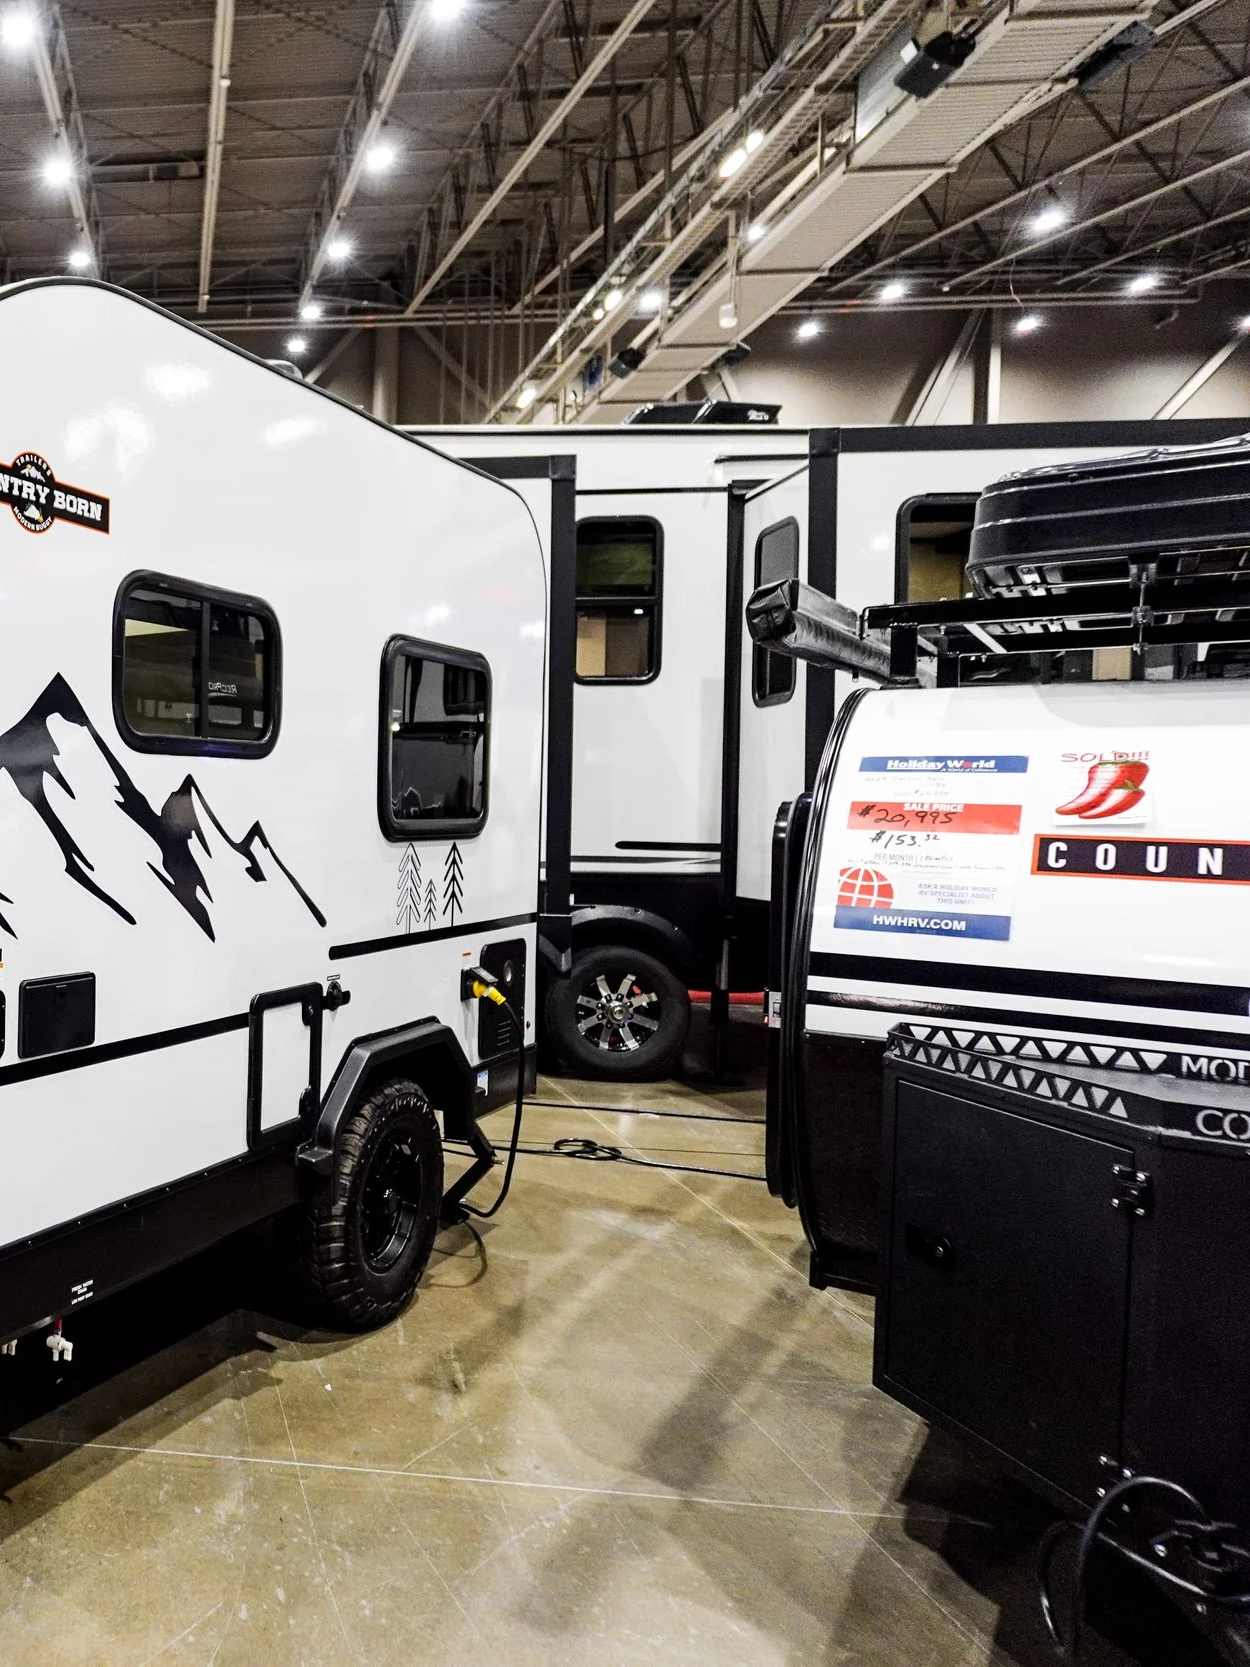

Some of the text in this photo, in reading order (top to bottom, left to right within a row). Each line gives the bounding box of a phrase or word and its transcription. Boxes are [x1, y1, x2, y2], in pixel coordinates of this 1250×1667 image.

[15, 454, 52, 476] TRAILERS
[53, 489, 103, 521] BORN
[13, 506, 53, 531] MODERN BUGGY
[886, 759, 996, 770] Holiday World
[1061, 750, 1150, 763] SOLD!!!
[857, 804, 957, 828] $20,995
[903, 803, 964, 812] SALE PRICE
[888, 854, 914, 862] MONTH
[1047, 841, 1224, 876] COUN
[930, 890, 968, 898] SPECIALIST
[872, 914, 967, 932] HWHRV.COM
